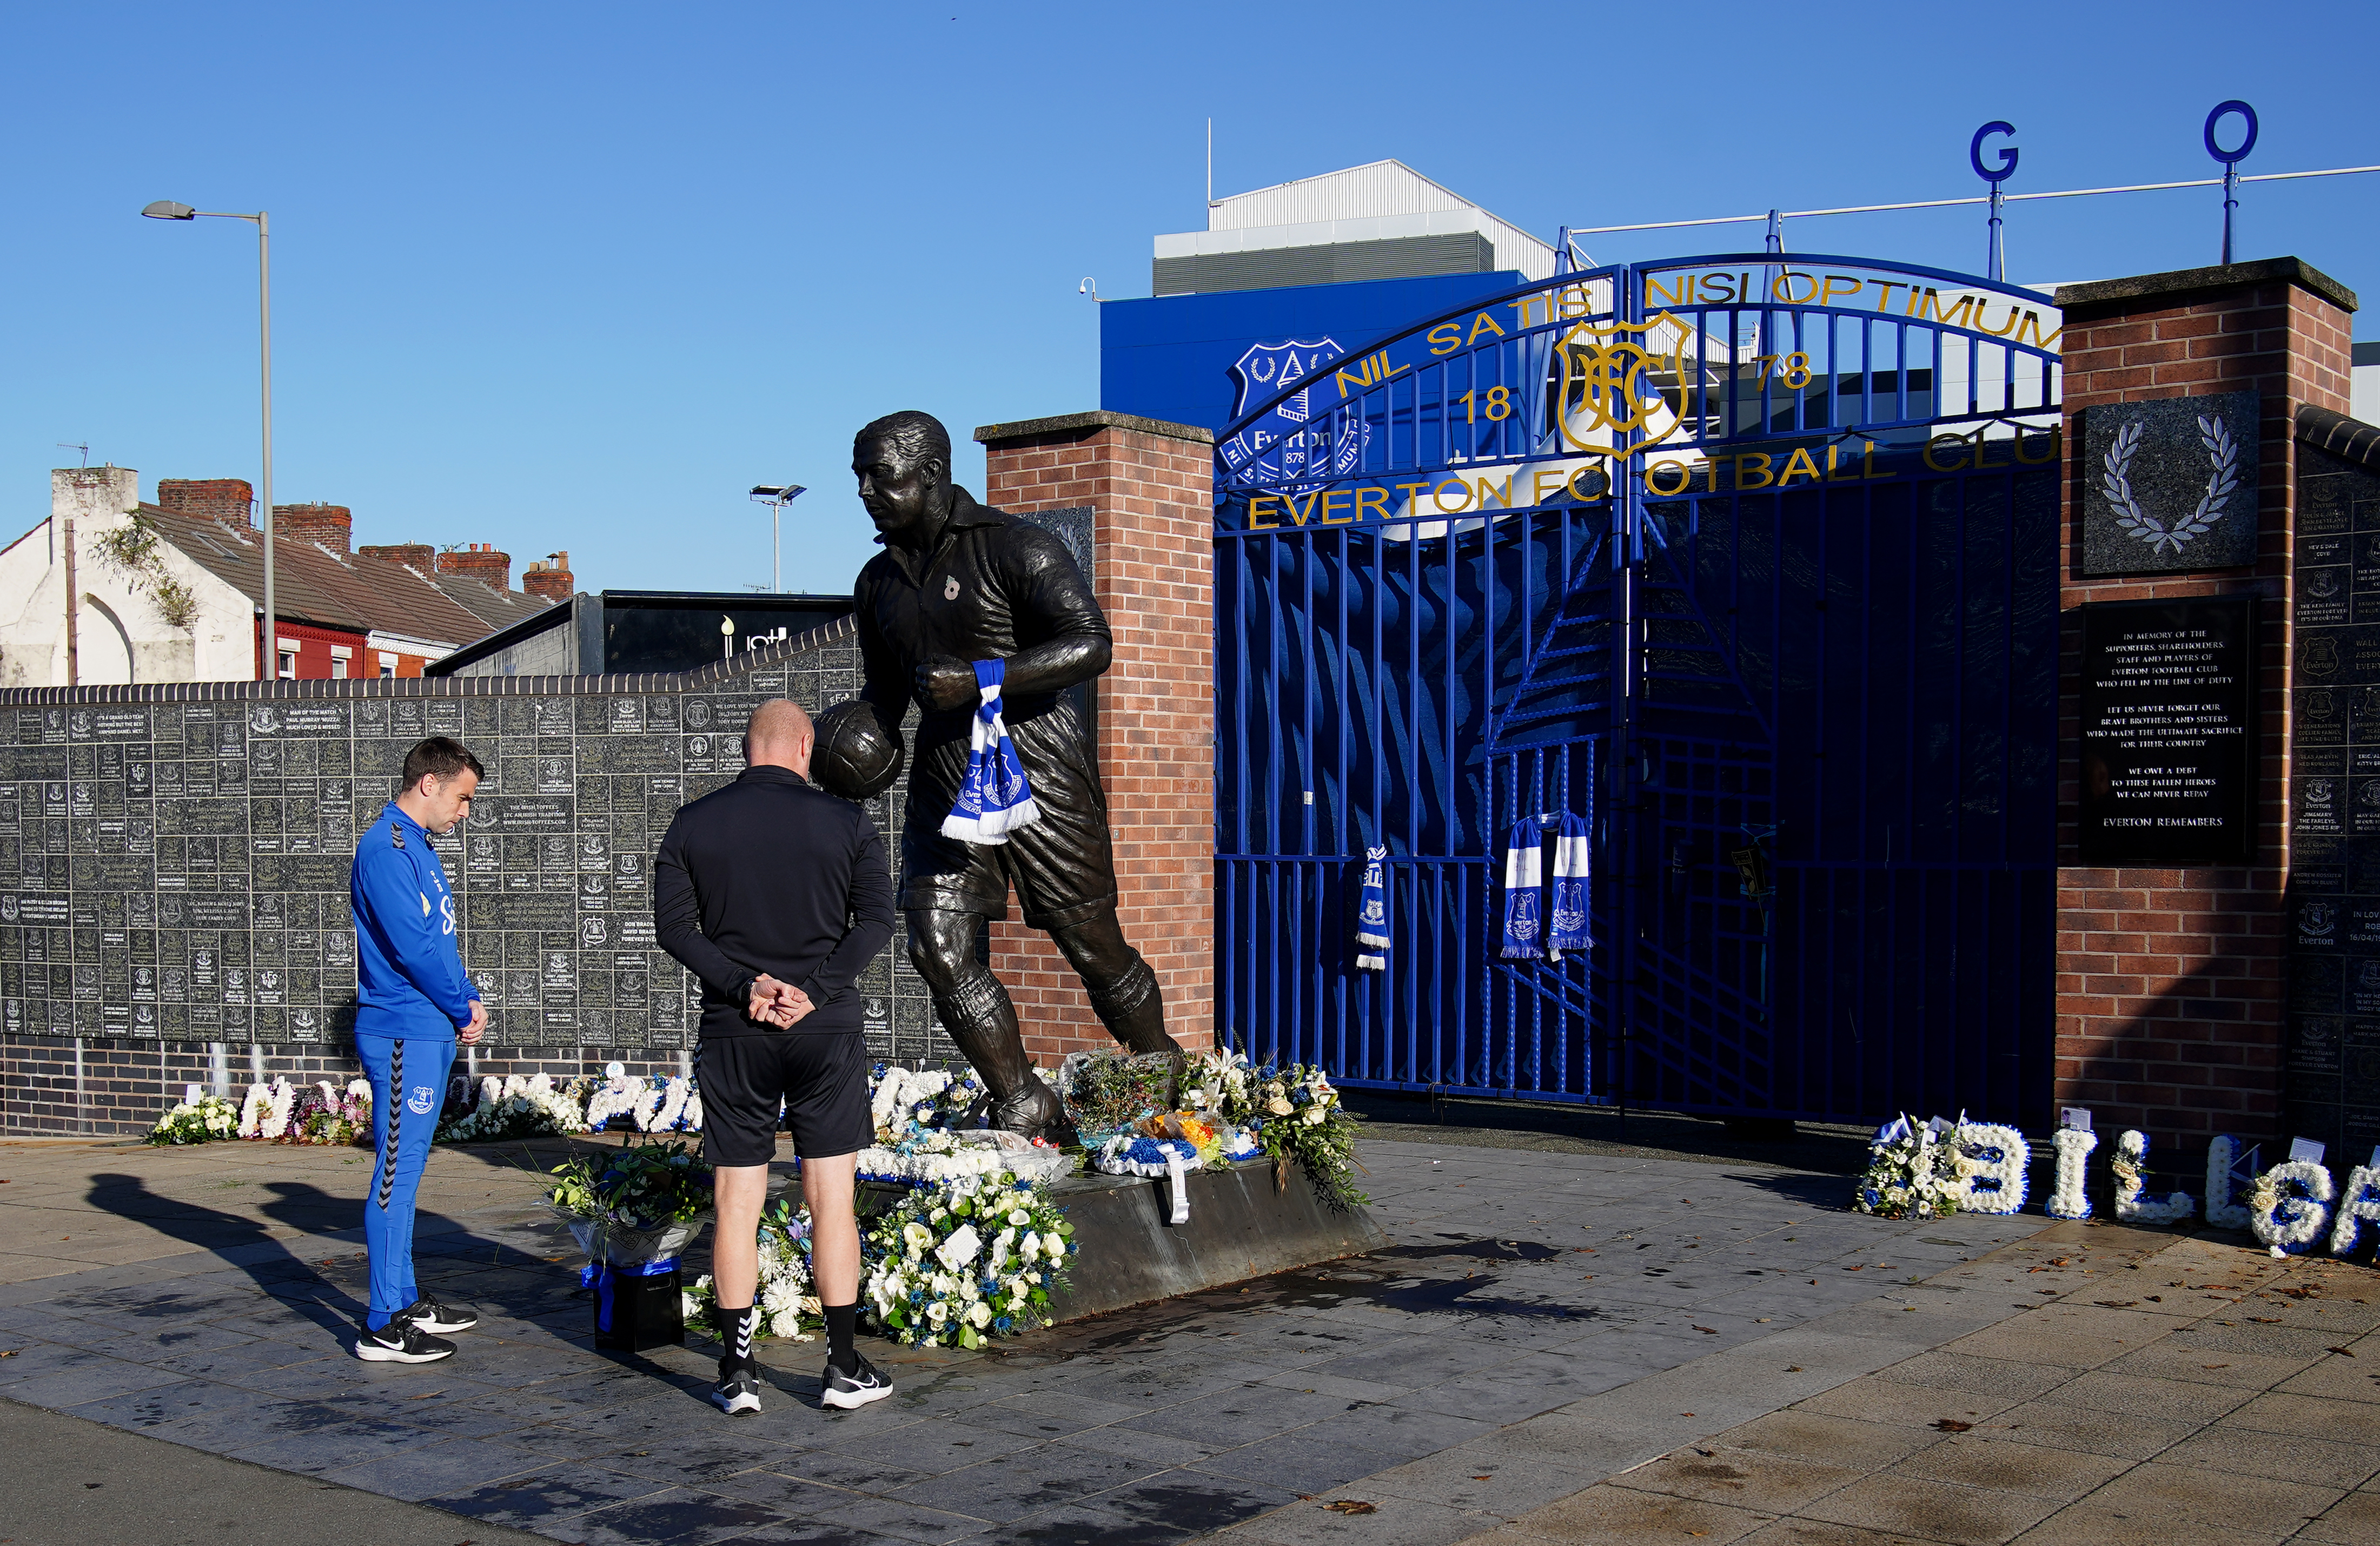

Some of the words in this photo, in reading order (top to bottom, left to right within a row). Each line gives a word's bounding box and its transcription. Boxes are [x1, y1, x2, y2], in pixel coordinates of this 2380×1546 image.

[1970, 120, 2019, 181] G
[2203, 99, 2258, 163] O
[1336, 349, 1410, 399] NIL
[1646, 272, 1748, 308] NISI
[1459, 386, 1511, 424] 18
[1752, 351, 1812, 392] 78
[1255, 430, 1331, 450] Evrton
[1285, 452, 1305, 464] 878
[1249, 474, 1513, 530] EVERTON
[2306, 661, 2333, 669] Everton
[2104, 818, 2151, 827] EVERTON
[2158, 818, 2222, 826] REMEMBERS
[2298, 936, 2333, 946] Everton
